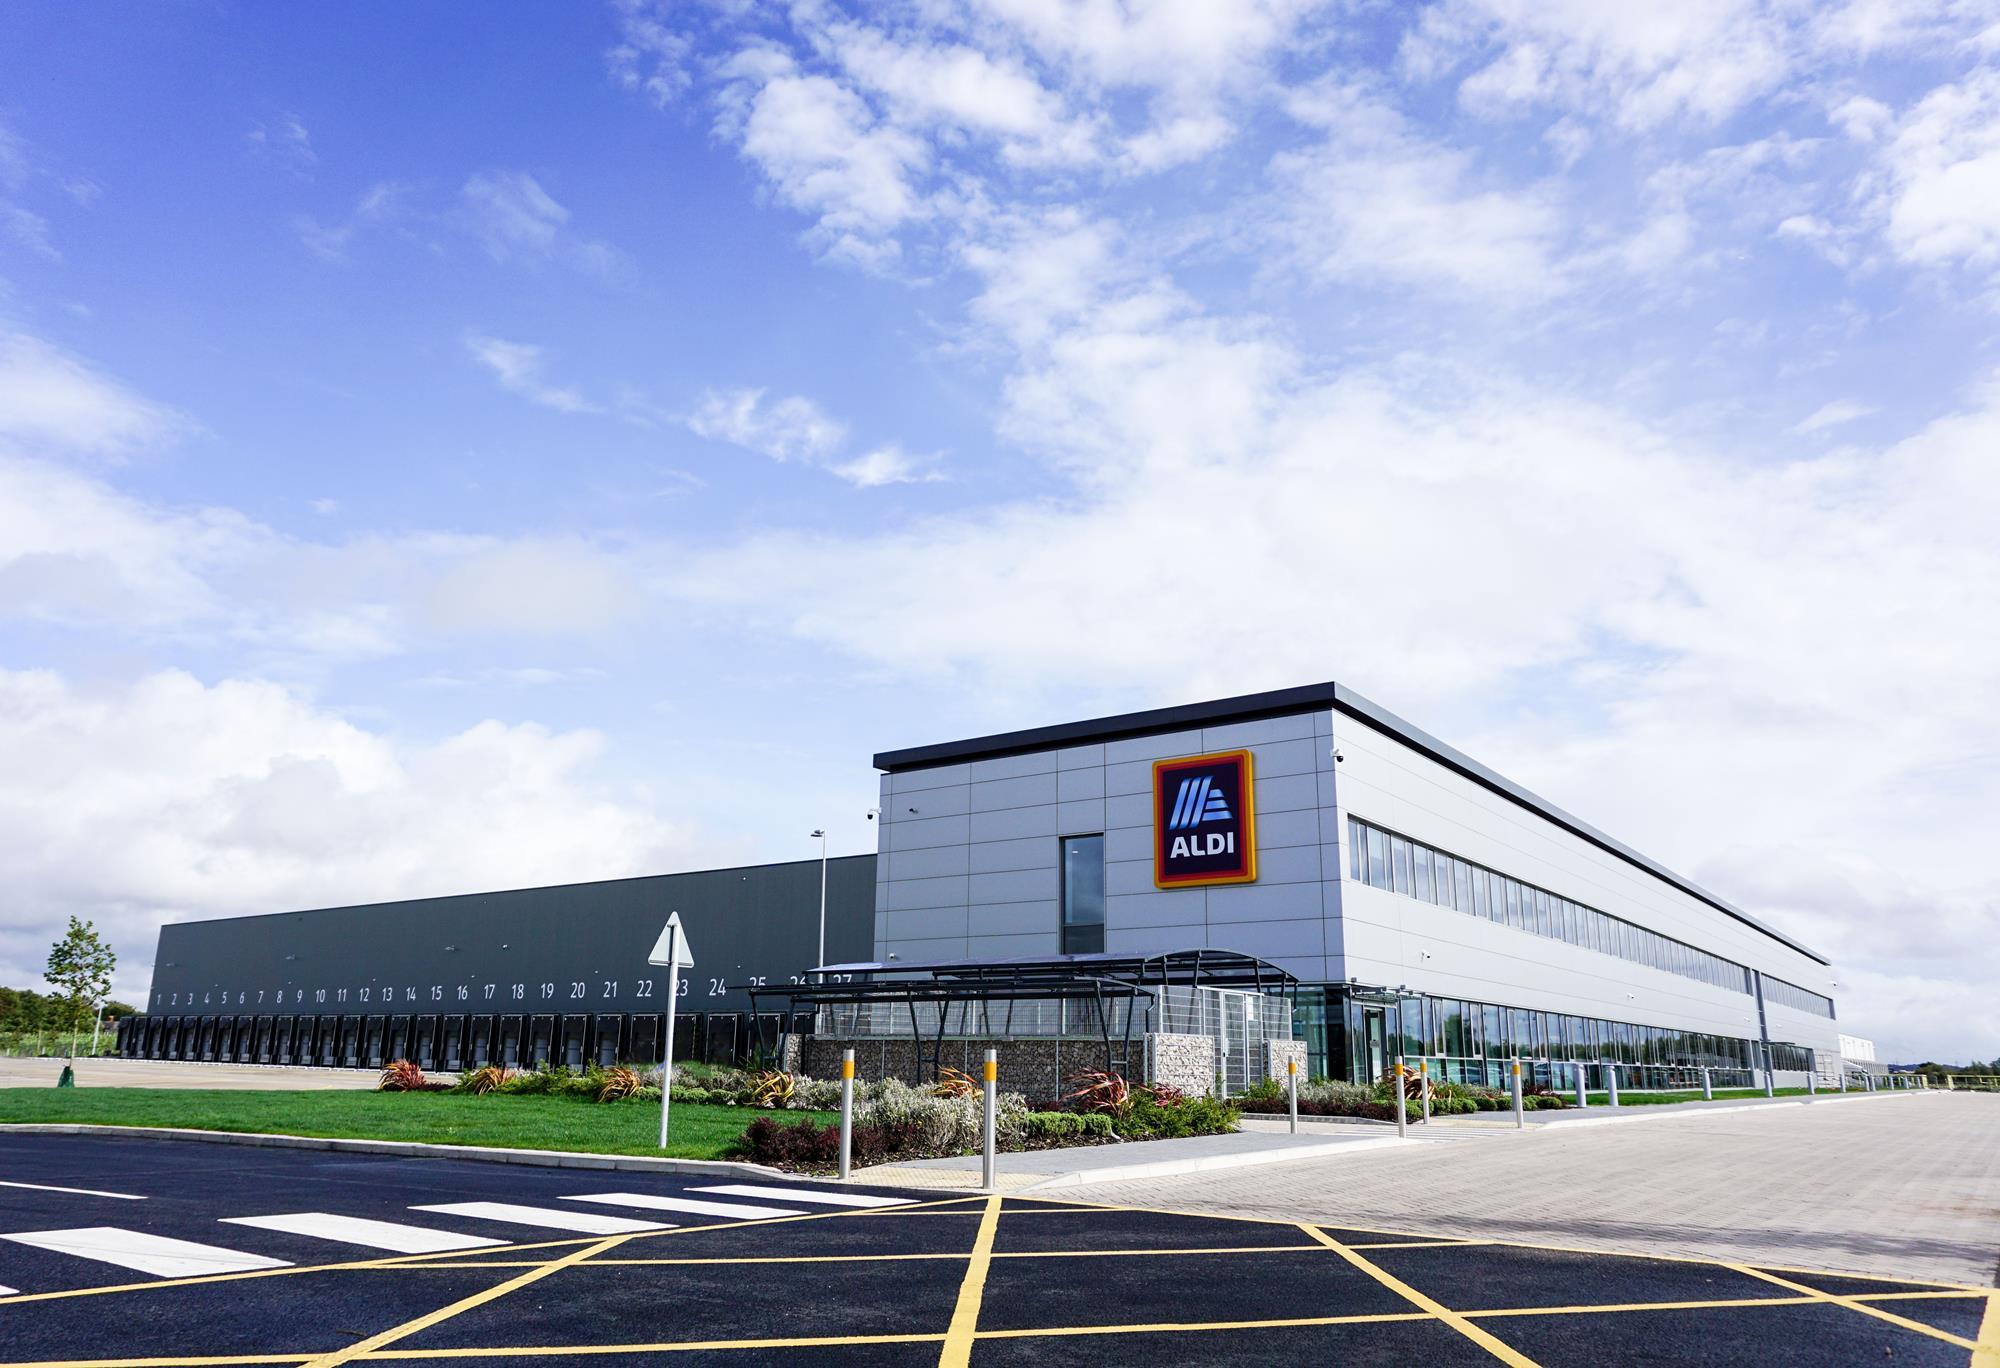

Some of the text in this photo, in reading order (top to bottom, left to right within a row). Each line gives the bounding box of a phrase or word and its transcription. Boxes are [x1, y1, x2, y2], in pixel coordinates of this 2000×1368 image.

[1170, 831, 1235, 859] ALDI
[156, 994, 162, 1006] 1
[170, 993, 178, 1006] 2
[187, 993, 194, 1006] 3
[203, 993, 210, 1005] 4
[221, 992, 228, 1005] 5
[239, 992, 246, 1005] 6
[257, 991, 265, 1004] 7
[276, 990, 283, 1004] 8
[296, 990, 303, 1004] 9
[316, 989, 326, 1003] 10
[338, 989, 348, 1002] 11
[360, 988, 370, 1002] 12
[383, 987, 393, 1002] 13
[406, 987, 417, 1001] 14
[431, 986, 443, 1001] 15
[457, 985, 468, 1001] 16
[484, 984, 496, 1000] 17
[512, 984, 525, 1000] 18
[541, 983, 555, 999] 19
[571, 982, 586, 999] 20
[603, 981, 618, 998] 21
[637, 980, 653, 998] 22
[709, 978, 727, 997] 24
